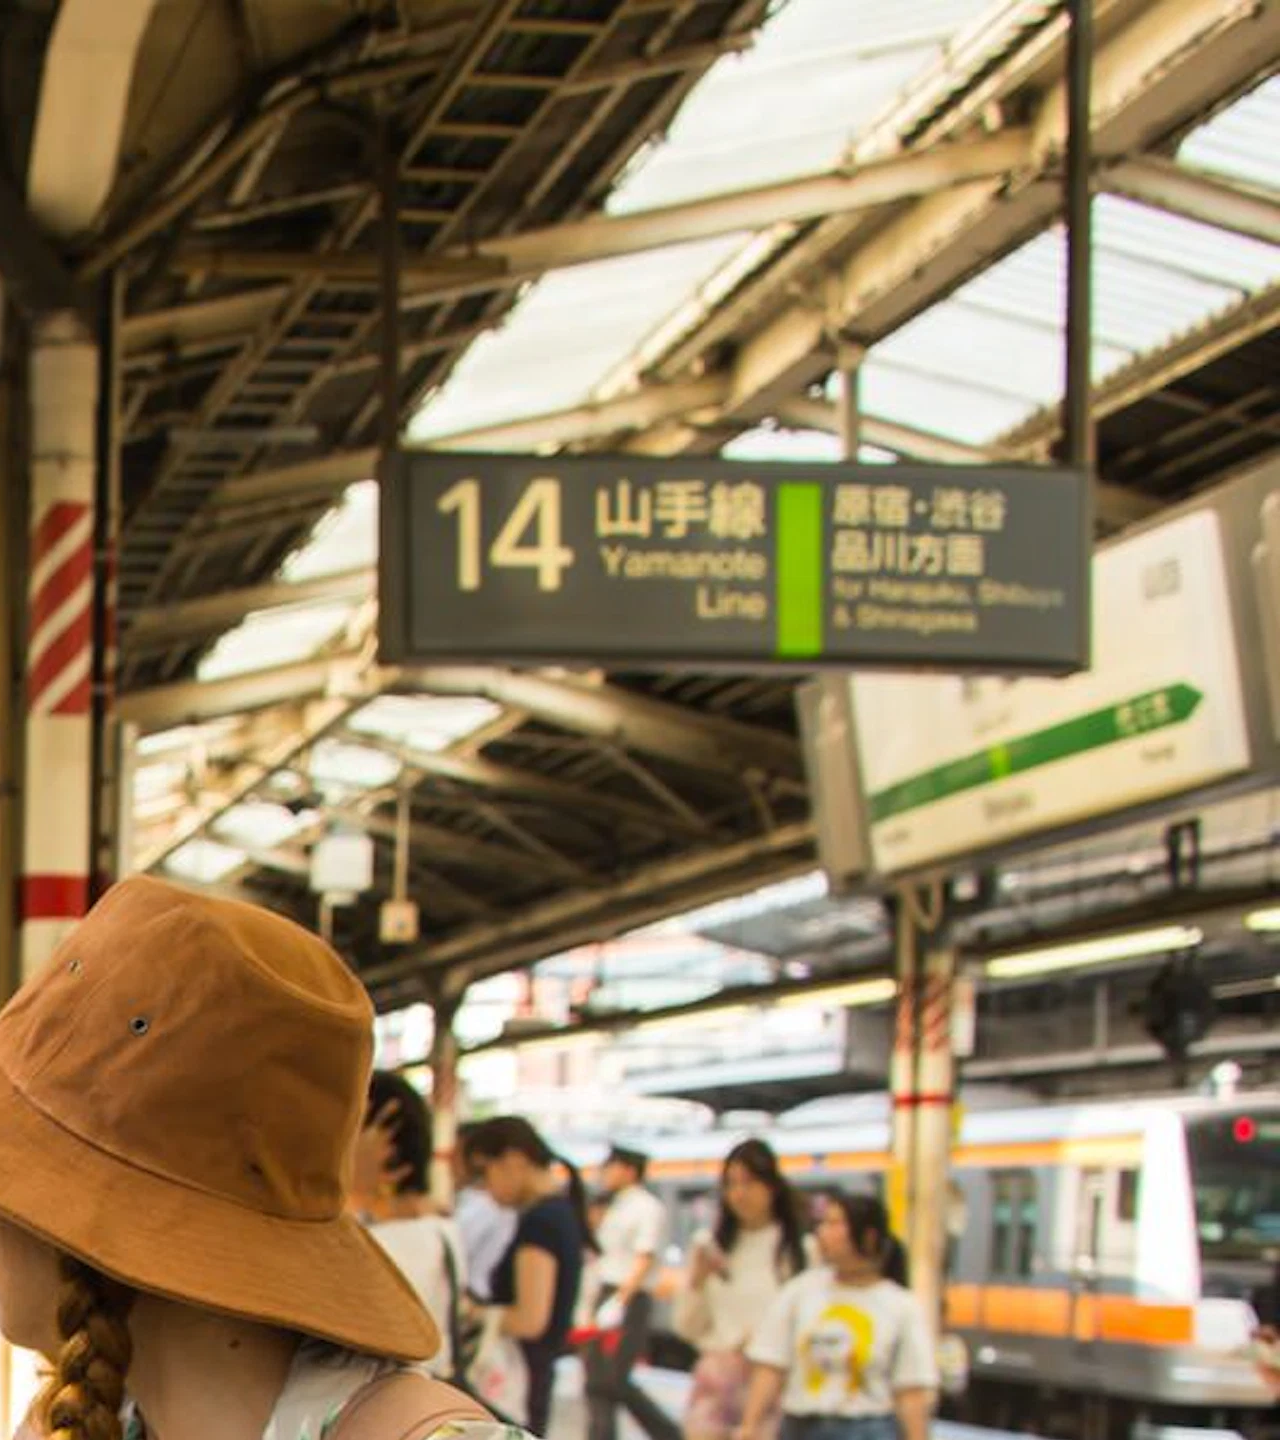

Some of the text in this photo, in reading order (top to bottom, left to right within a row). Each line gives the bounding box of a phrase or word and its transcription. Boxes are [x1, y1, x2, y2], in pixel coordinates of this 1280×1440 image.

[596, 479, 766, 540] 山手線
[438, 477, 575, 592] 14
[599, 544, 767, 580] Yamanote
[697, 584, 767, 620] Line
